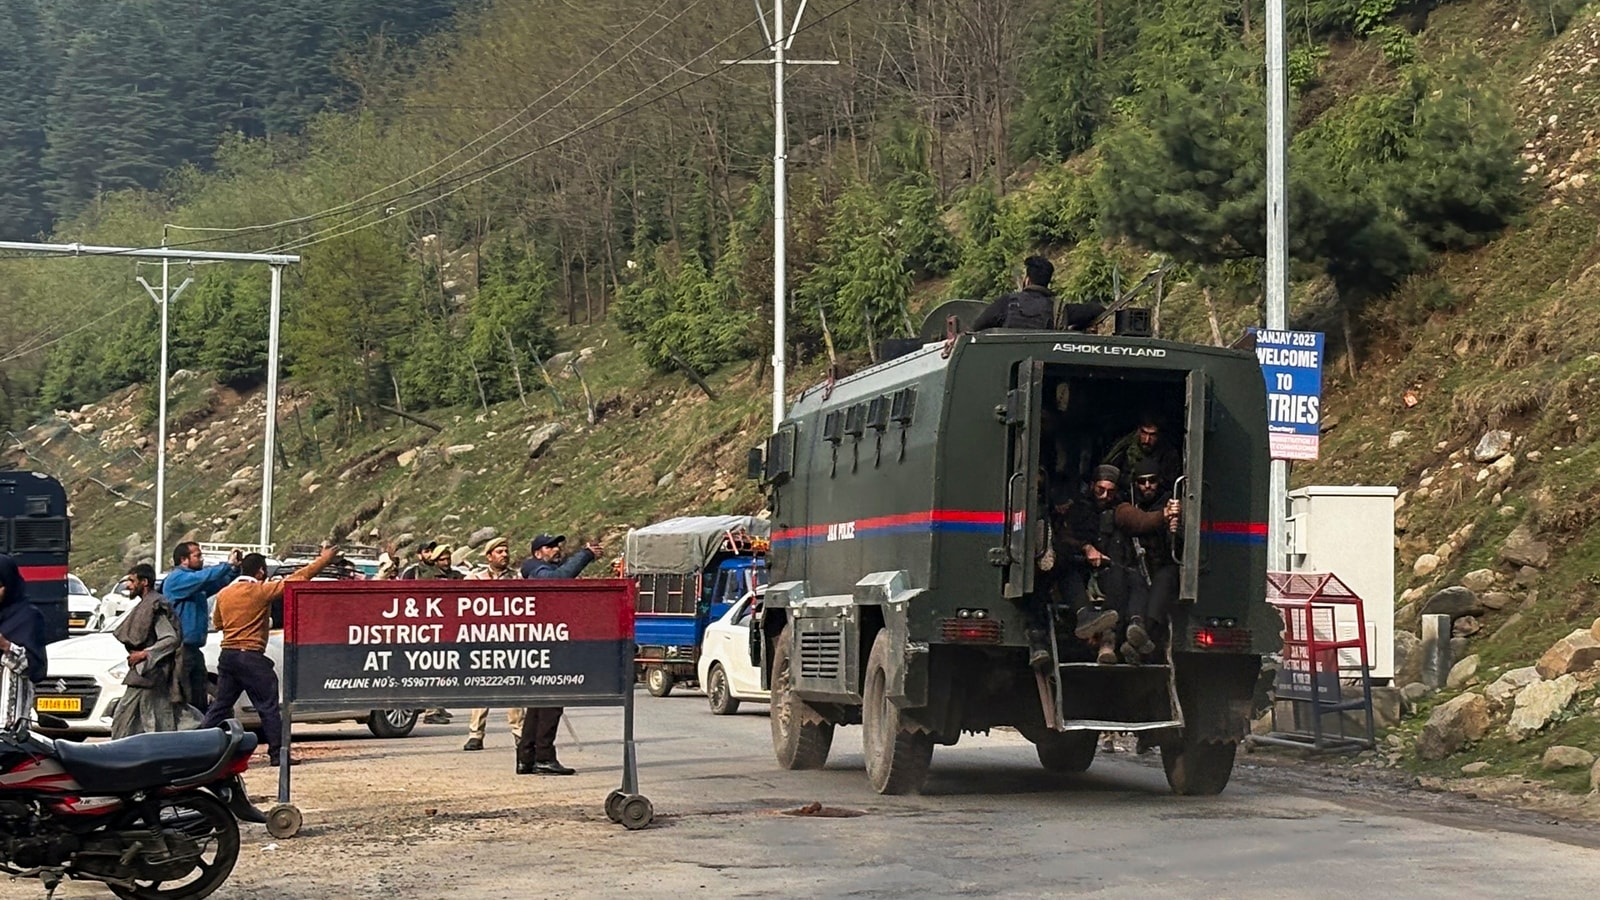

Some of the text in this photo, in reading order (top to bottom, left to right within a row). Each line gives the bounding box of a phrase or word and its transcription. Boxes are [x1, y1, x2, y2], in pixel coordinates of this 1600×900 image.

[1256, 331, 1316, 347] SANJAY 2023
[1053, 343, 1167, 358] ASHOK LEYLAND
[1256, 347, 1318, 368] WELCOME
[1276, 373, 1293, 391] TO
[838, 521, 856, 541] POLICE
[457, 596, 536, 617] POLICE
[348, 623, 569, 645] DISTRICT ANANTNAG
[363, 649, 551, 672] AT YOUR SERVICE
[324, 678, 369, 689] HELPLINE
[529, 674, 585, 686] 9419051940
